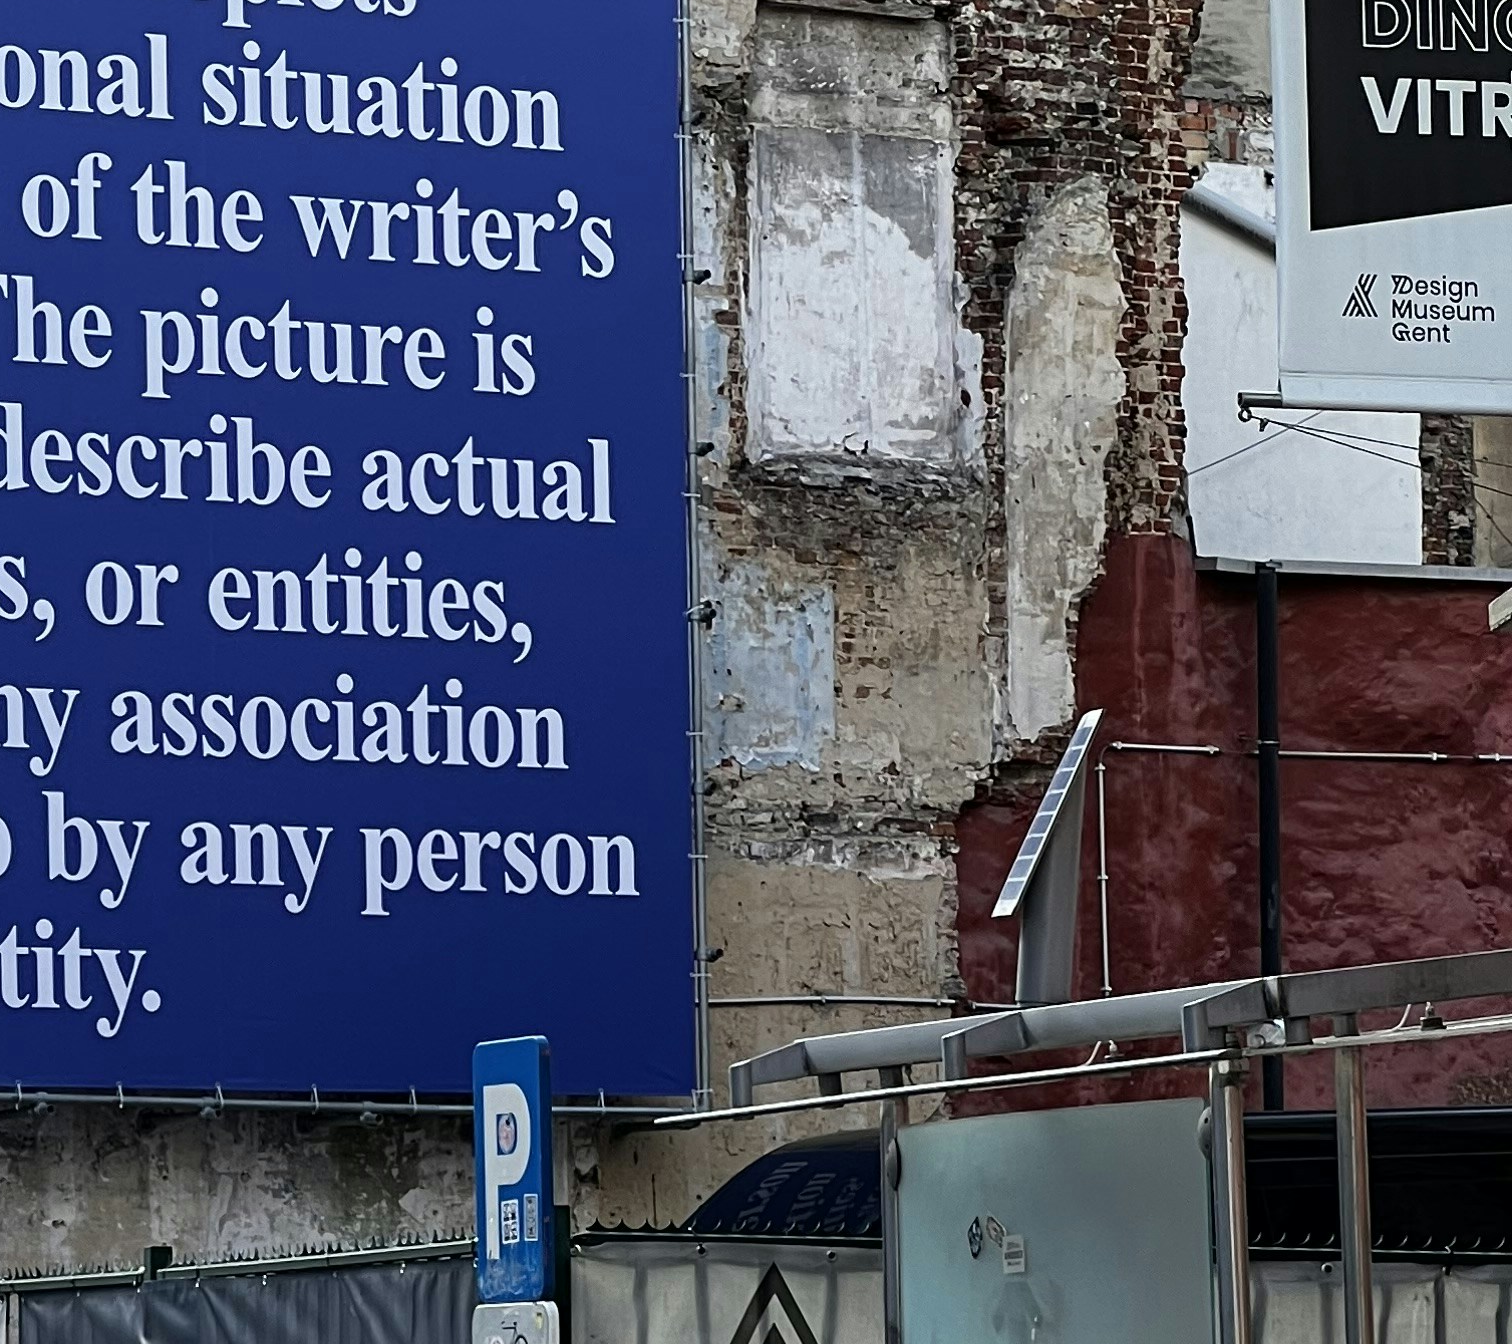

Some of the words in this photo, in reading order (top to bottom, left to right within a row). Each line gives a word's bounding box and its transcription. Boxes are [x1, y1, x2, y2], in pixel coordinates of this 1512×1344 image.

[202, 41, 564, 151] situation
[22, 153, 112, 239] of
[130, 160, 263, 252] the
[1391, 275, 1478, 304] Design
[1392, 299, 1495, 321] Museum
[1392, 322, 1451, 343] Gent
[140, 288, 445, 398] picture
[472, 307, 535, 395] is
[362, 436, 616, 523] actual
[86, 562, 178, 625] or
[209, 548, 532, 663] entities,
[111, 674, 569, 769] association
[42, 791, 150, 908] by
[181, 822, 333, 913] any
[360, 828, 639, 915] person
[483, 1083, 531, 1260] P
